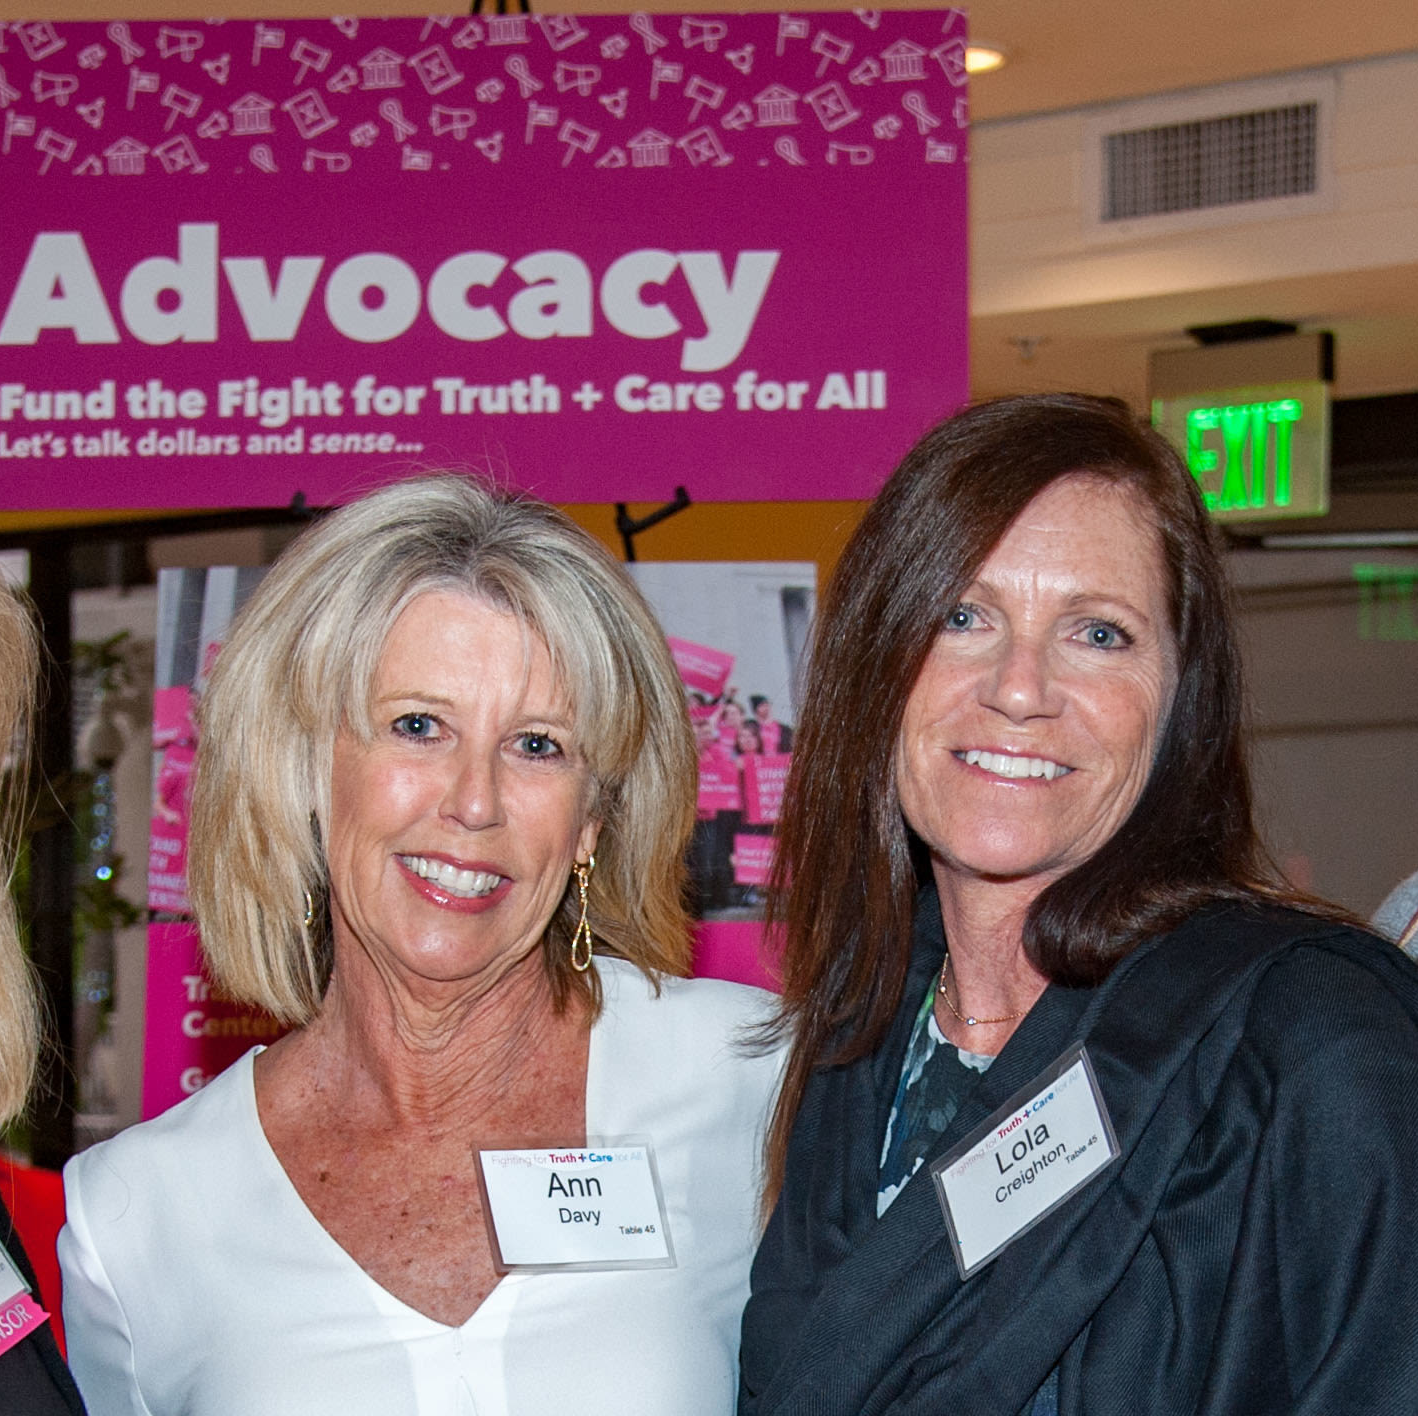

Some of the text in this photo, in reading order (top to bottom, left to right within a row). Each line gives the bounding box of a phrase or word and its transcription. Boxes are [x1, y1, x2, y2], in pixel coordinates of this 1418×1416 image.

[126, 379, 207, 419] the
[217, 376, 344, 429] Fight
[351, 374, 426, 416] for
[433, 374, 561, 414] Truth
[572, 382, 603, 412] +
[614, 374, 725, 413] Care
[733, 370, 810, 412] for
[815, 370, 888, 411] All
[73, 429, 131, 458] talk
[136, 428, 241, 457] dollars
[246, 427, 305, 455] and
[309, 431, 425, 454] sense...
[1187, 399, 1302, 513] EXIT
[997, 1117, 1023, 1139] Truth
[1032, 1092, 1054, 1112] Care
[548, 1153, 577, 1164] Truth
[588, 1153, 613, 1163] Care
[995, 1123, 1050, 1175] Lola
[1065, 1134, 1098, 1164] Table 45
[548, 1172, 602, 1198] Ann
[995, 1141, 1067, 1203] Creighton
[559, 1207, 601, 1226] Davy
[619, 1225, 656, 1235] Table 45
